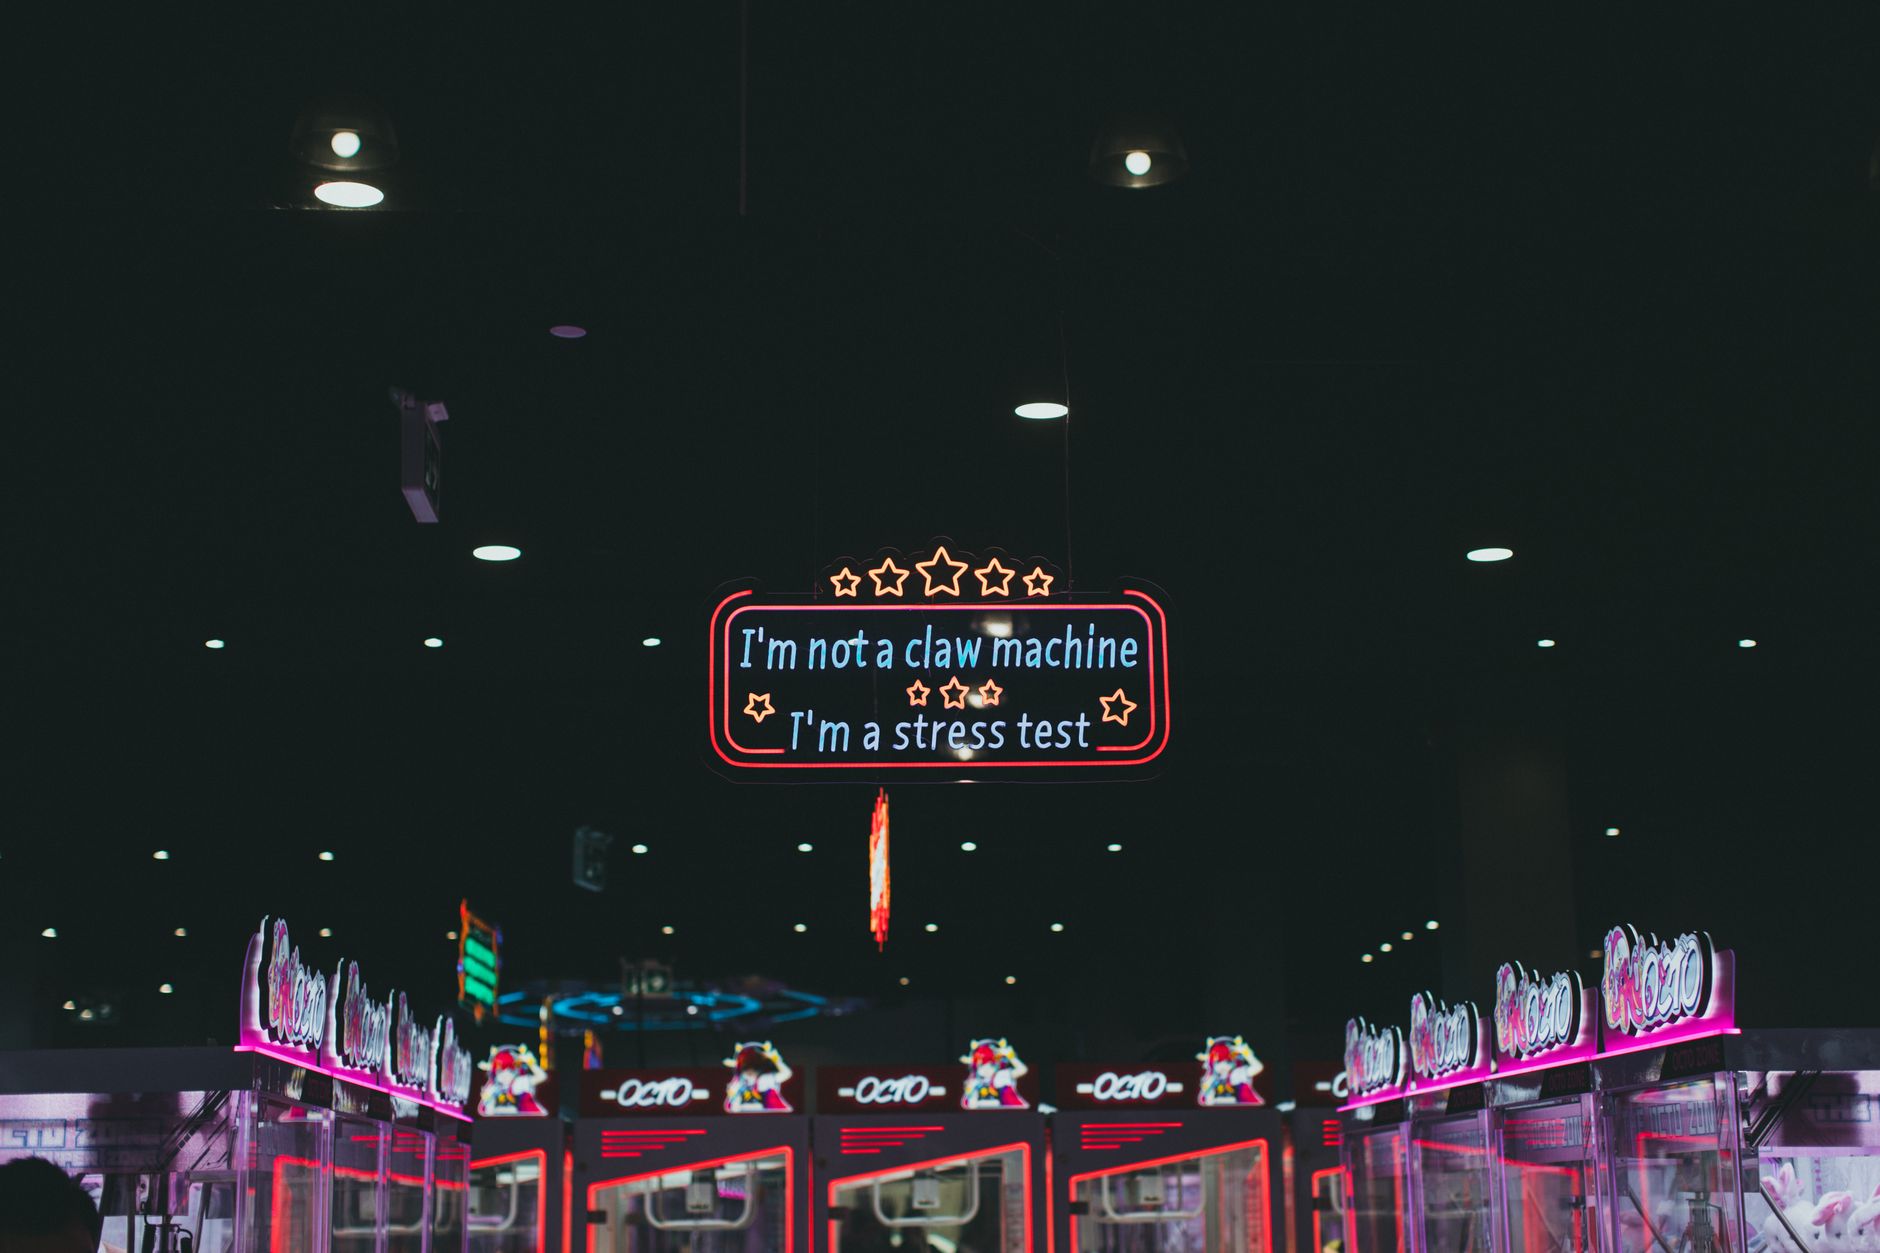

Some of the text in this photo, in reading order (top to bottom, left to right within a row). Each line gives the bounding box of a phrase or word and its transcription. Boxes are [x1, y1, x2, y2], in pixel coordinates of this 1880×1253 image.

[740, 623, 1138, 671] I'm not a claw machine
[790, 709, 1091, 753] I'm a stress test
